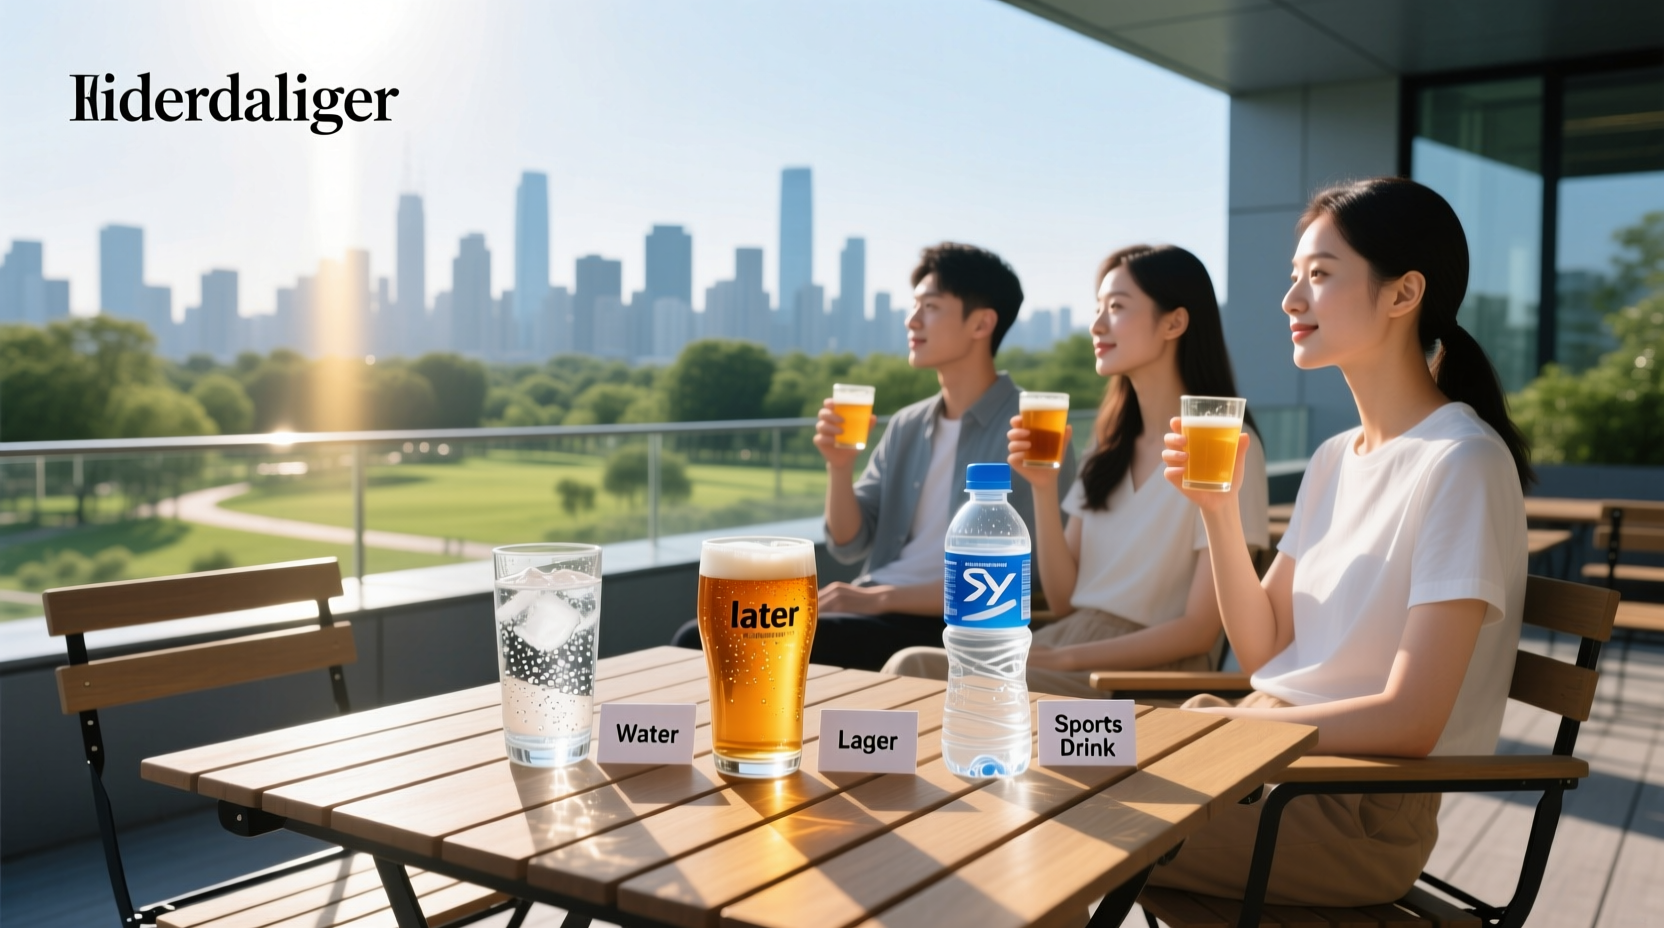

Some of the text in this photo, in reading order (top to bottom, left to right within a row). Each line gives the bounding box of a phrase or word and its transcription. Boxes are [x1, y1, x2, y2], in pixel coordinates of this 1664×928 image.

[731, 600, 800, 629] later
[616, 723, 680, 745] Water
[1054, 713, 1123, 737] Sports
[838, 729, 899, 755] Lager
[1060, 737, 1117, 758] Drink
